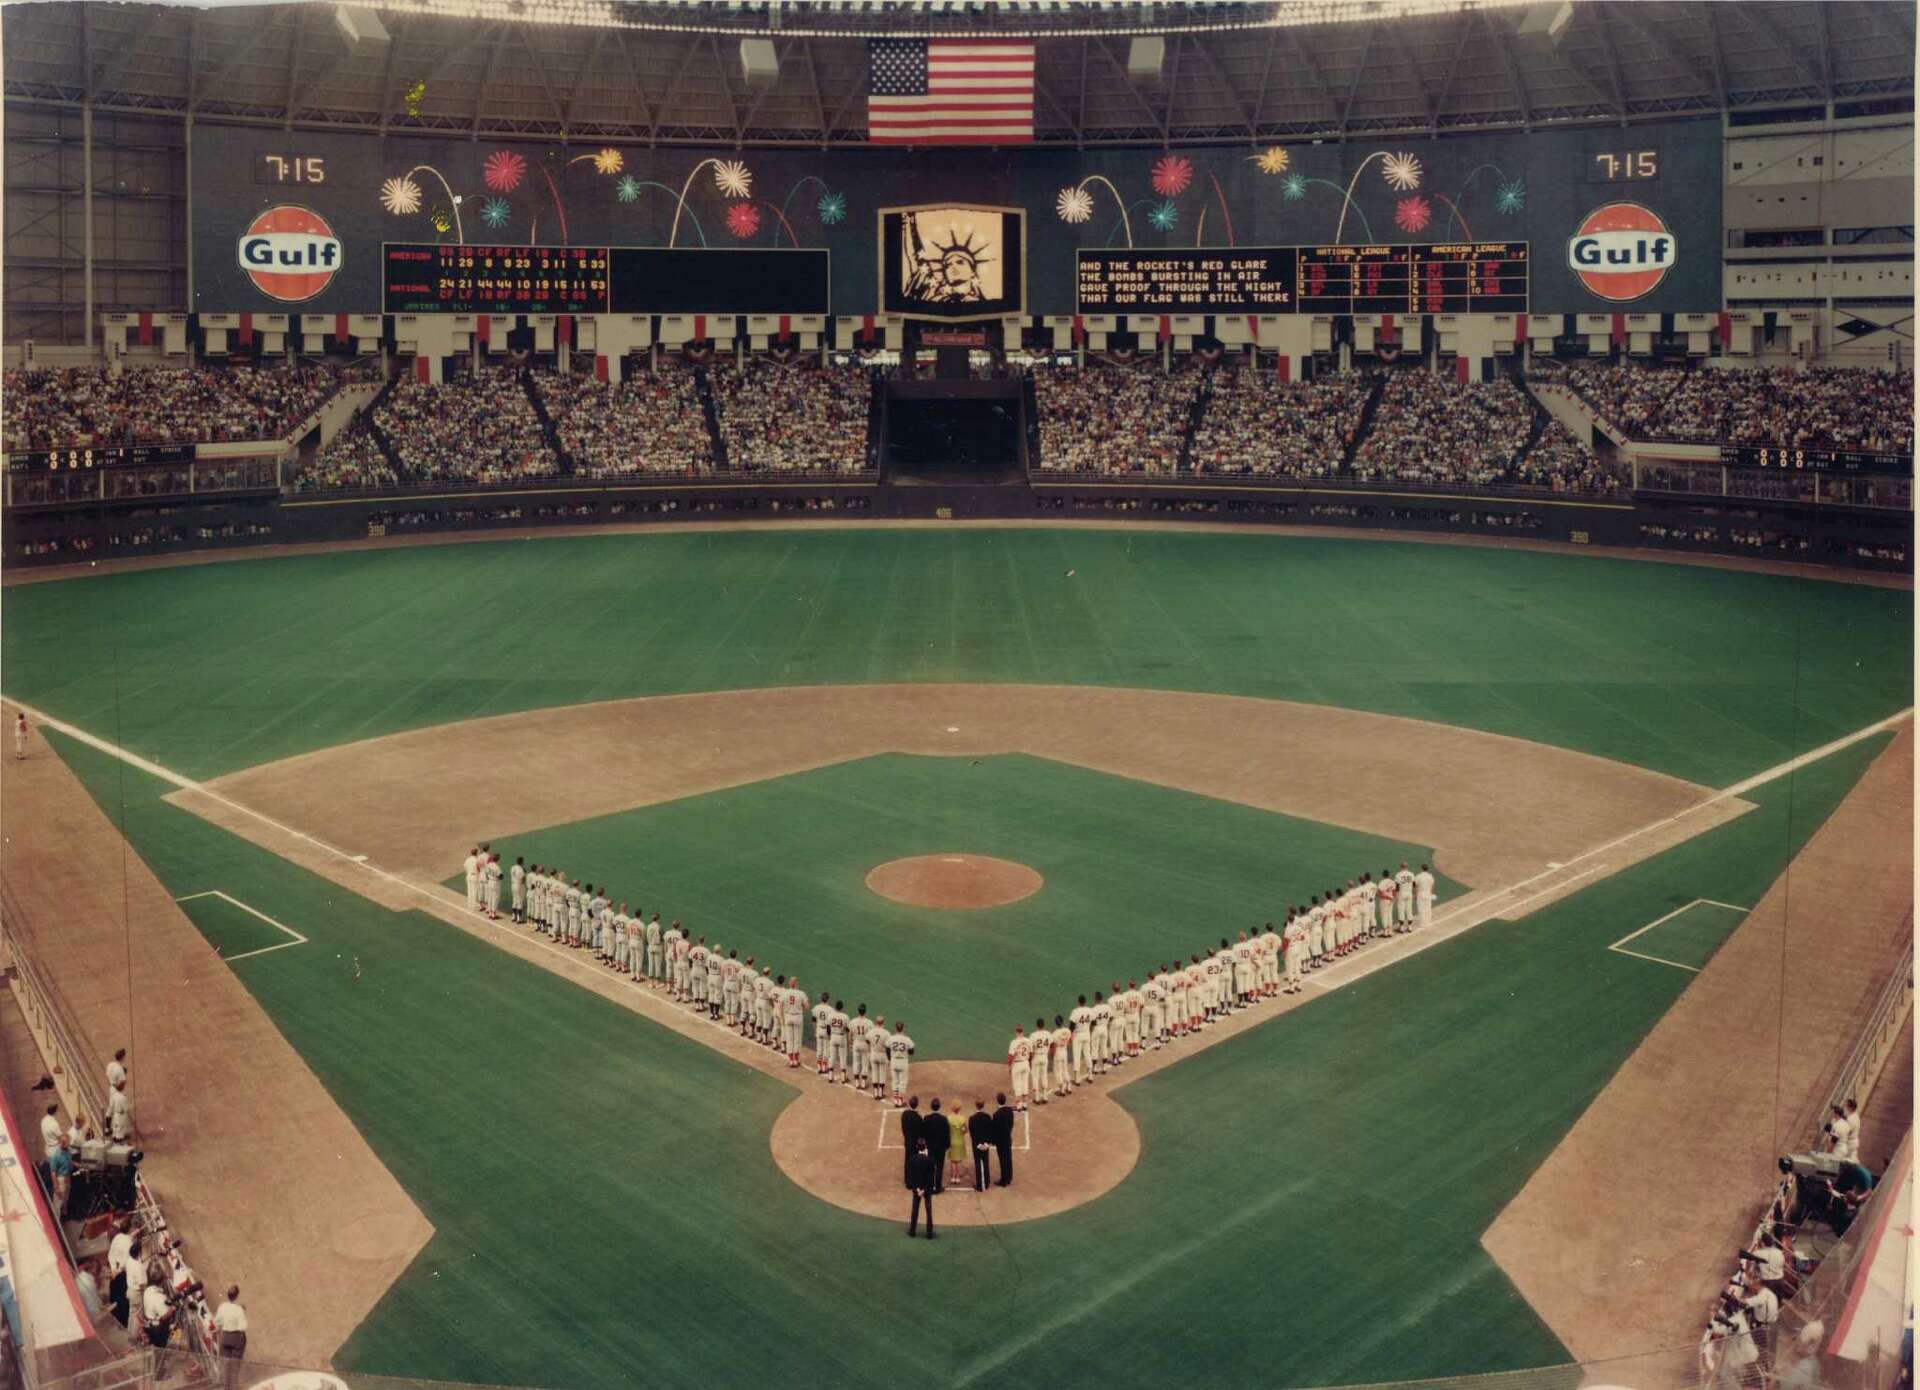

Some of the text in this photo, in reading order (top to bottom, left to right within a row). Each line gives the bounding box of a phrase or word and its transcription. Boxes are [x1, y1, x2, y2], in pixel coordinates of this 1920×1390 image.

[265, 156, 325, 182] 7:15
[1597, 152, 1656, 178] 7:15
[245, 238, 336, 266] Gulf
[1574, 238, 1669, 265] Gulf
[441, 258, 453, 267] 11
[515, 259, 531, 269] 23
[554, 259, 566, 269] 11
[1080, 260, 1268, 271] AND THE ROCKET'S RED GLARE
[1081, 271, 1260, 281] THE BOMBS BURSTING IN AIR
[440, 279, 454, 289] 24
[459, 279, 472, 289] 21
[478, 280, 493, 289] 44
[497, 280, 512, 289] 44
[517, 280, 530, 289] 10
[574, 280, 585, 290] 11
[1080, 282, 1282, 292] GAVE PROOF THROUGH THE NIGHT
[1081, 293, 1289, 303] THAT OUR FLAG WAS STILL THERE
[50, 452, 57, 460] 0
[70, 451, 77, 459] 0
[85, 450, 92, 459] 0
[1760, 449, 1767, 457] 0
[1780, 450, 1787, 458] 0
[1796, 451, 1803, 459] 0
[50, 461, 57, 469] 0
[70, 460, 77, 468] 0
[85, 459, 92, 468] 0
[1760, 457, 1767, 466] 0
[1780, 458, 1787, 467] 0
[1796, 459, 1803, 468] 0
[693, 953, 704, 961] 43
[1207, 965, 1219, 975] 23
[1148, 990, 1157, 999] 15
[789, 995, 795, 1005] 9
[831, 1018, 843, 1028] 29
[857, 1025, 865, 1035] 11
[875, 1034, 881, 1044] 7
[1037, 1039, 1049, 1048] 24
[892, 1042, 906, 1051] 23
